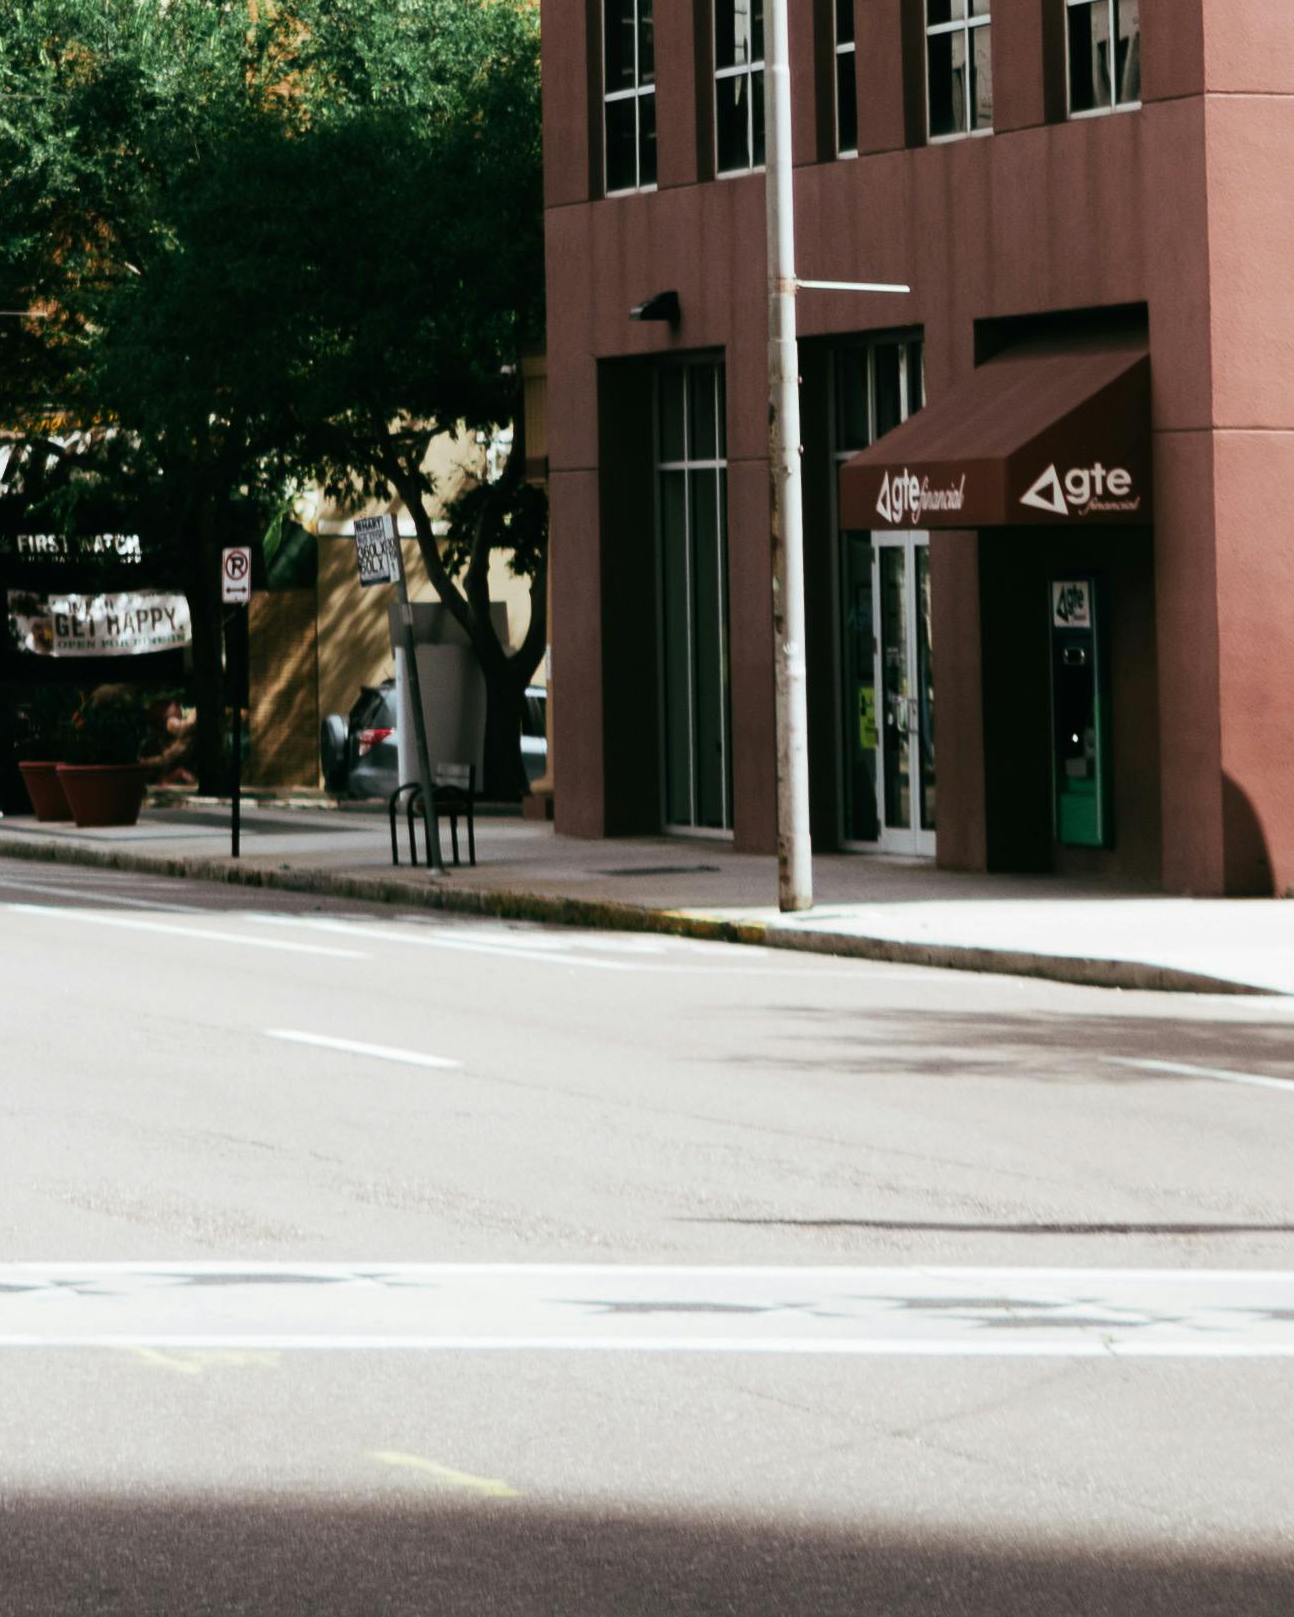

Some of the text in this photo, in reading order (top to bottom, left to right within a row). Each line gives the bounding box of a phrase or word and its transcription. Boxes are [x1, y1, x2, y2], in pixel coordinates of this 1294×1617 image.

[1064, 463, 1133, 505] gte
[16, 533, 69, 554] FIRST
[55, 606, 185, 638] GET HAPPY.
[57, 638, 96, 649] OPEN
